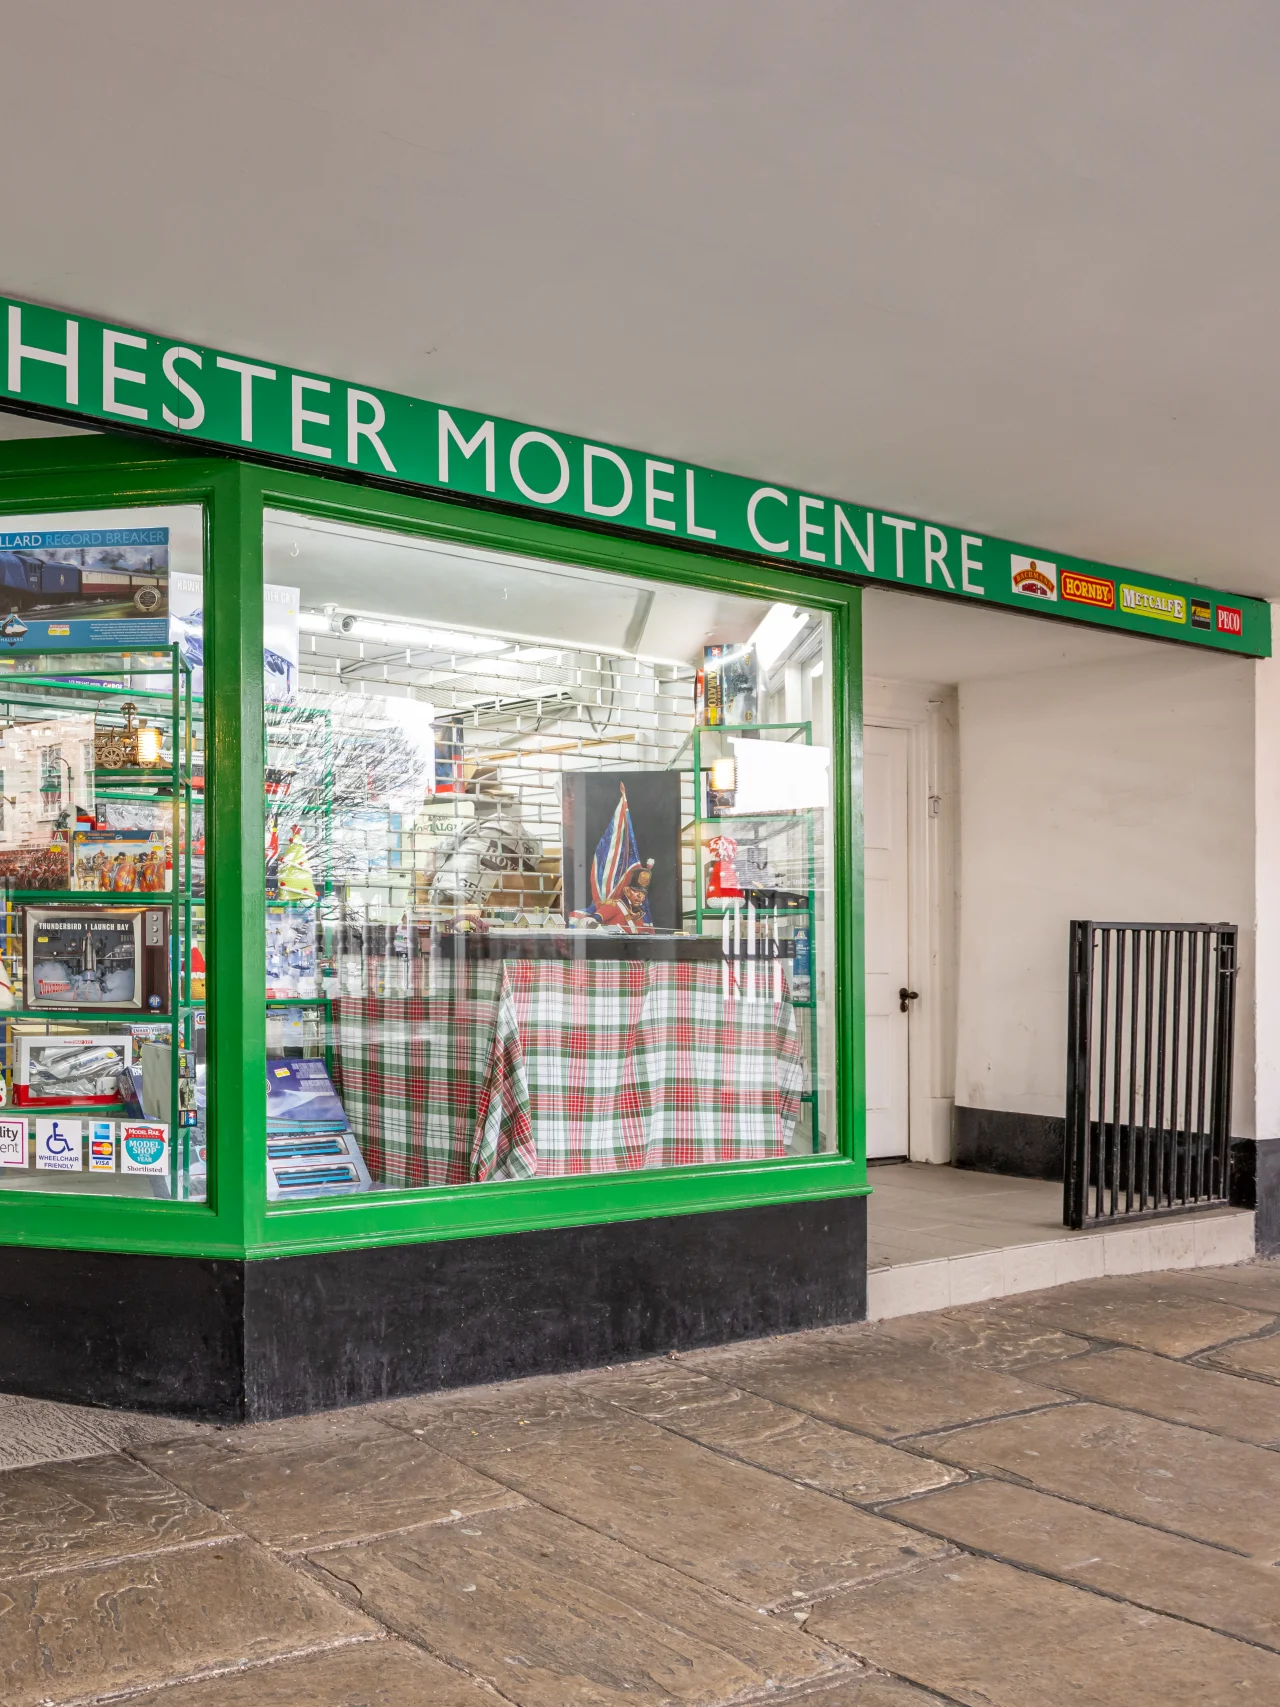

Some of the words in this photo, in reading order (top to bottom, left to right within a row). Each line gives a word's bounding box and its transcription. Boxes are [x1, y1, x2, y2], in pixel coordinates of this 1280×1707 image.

[437, 409, 717, 540] MODEL
[746, 487, 985, 595] CENTRE
[45, 533, 102, 546] RECORD
[105, 530, 165, 544] BREAKER
[1016, 570, 1053, 590] BACHMANN
[1065, 578, 1109, 602] HORNBY
[1122, 588, 1184, 619] METCALFE
[1218, 609, 1240, 632] PECO
[39, 922, 82, 931] THUNDERBIRD
[90, 923, 115, 931] LAUNCH
[117, 923, 129, 931] BAY
[129, 1140, 161, 1149] MODEL
[127, 1165, 162, 1173] Shortlisted
